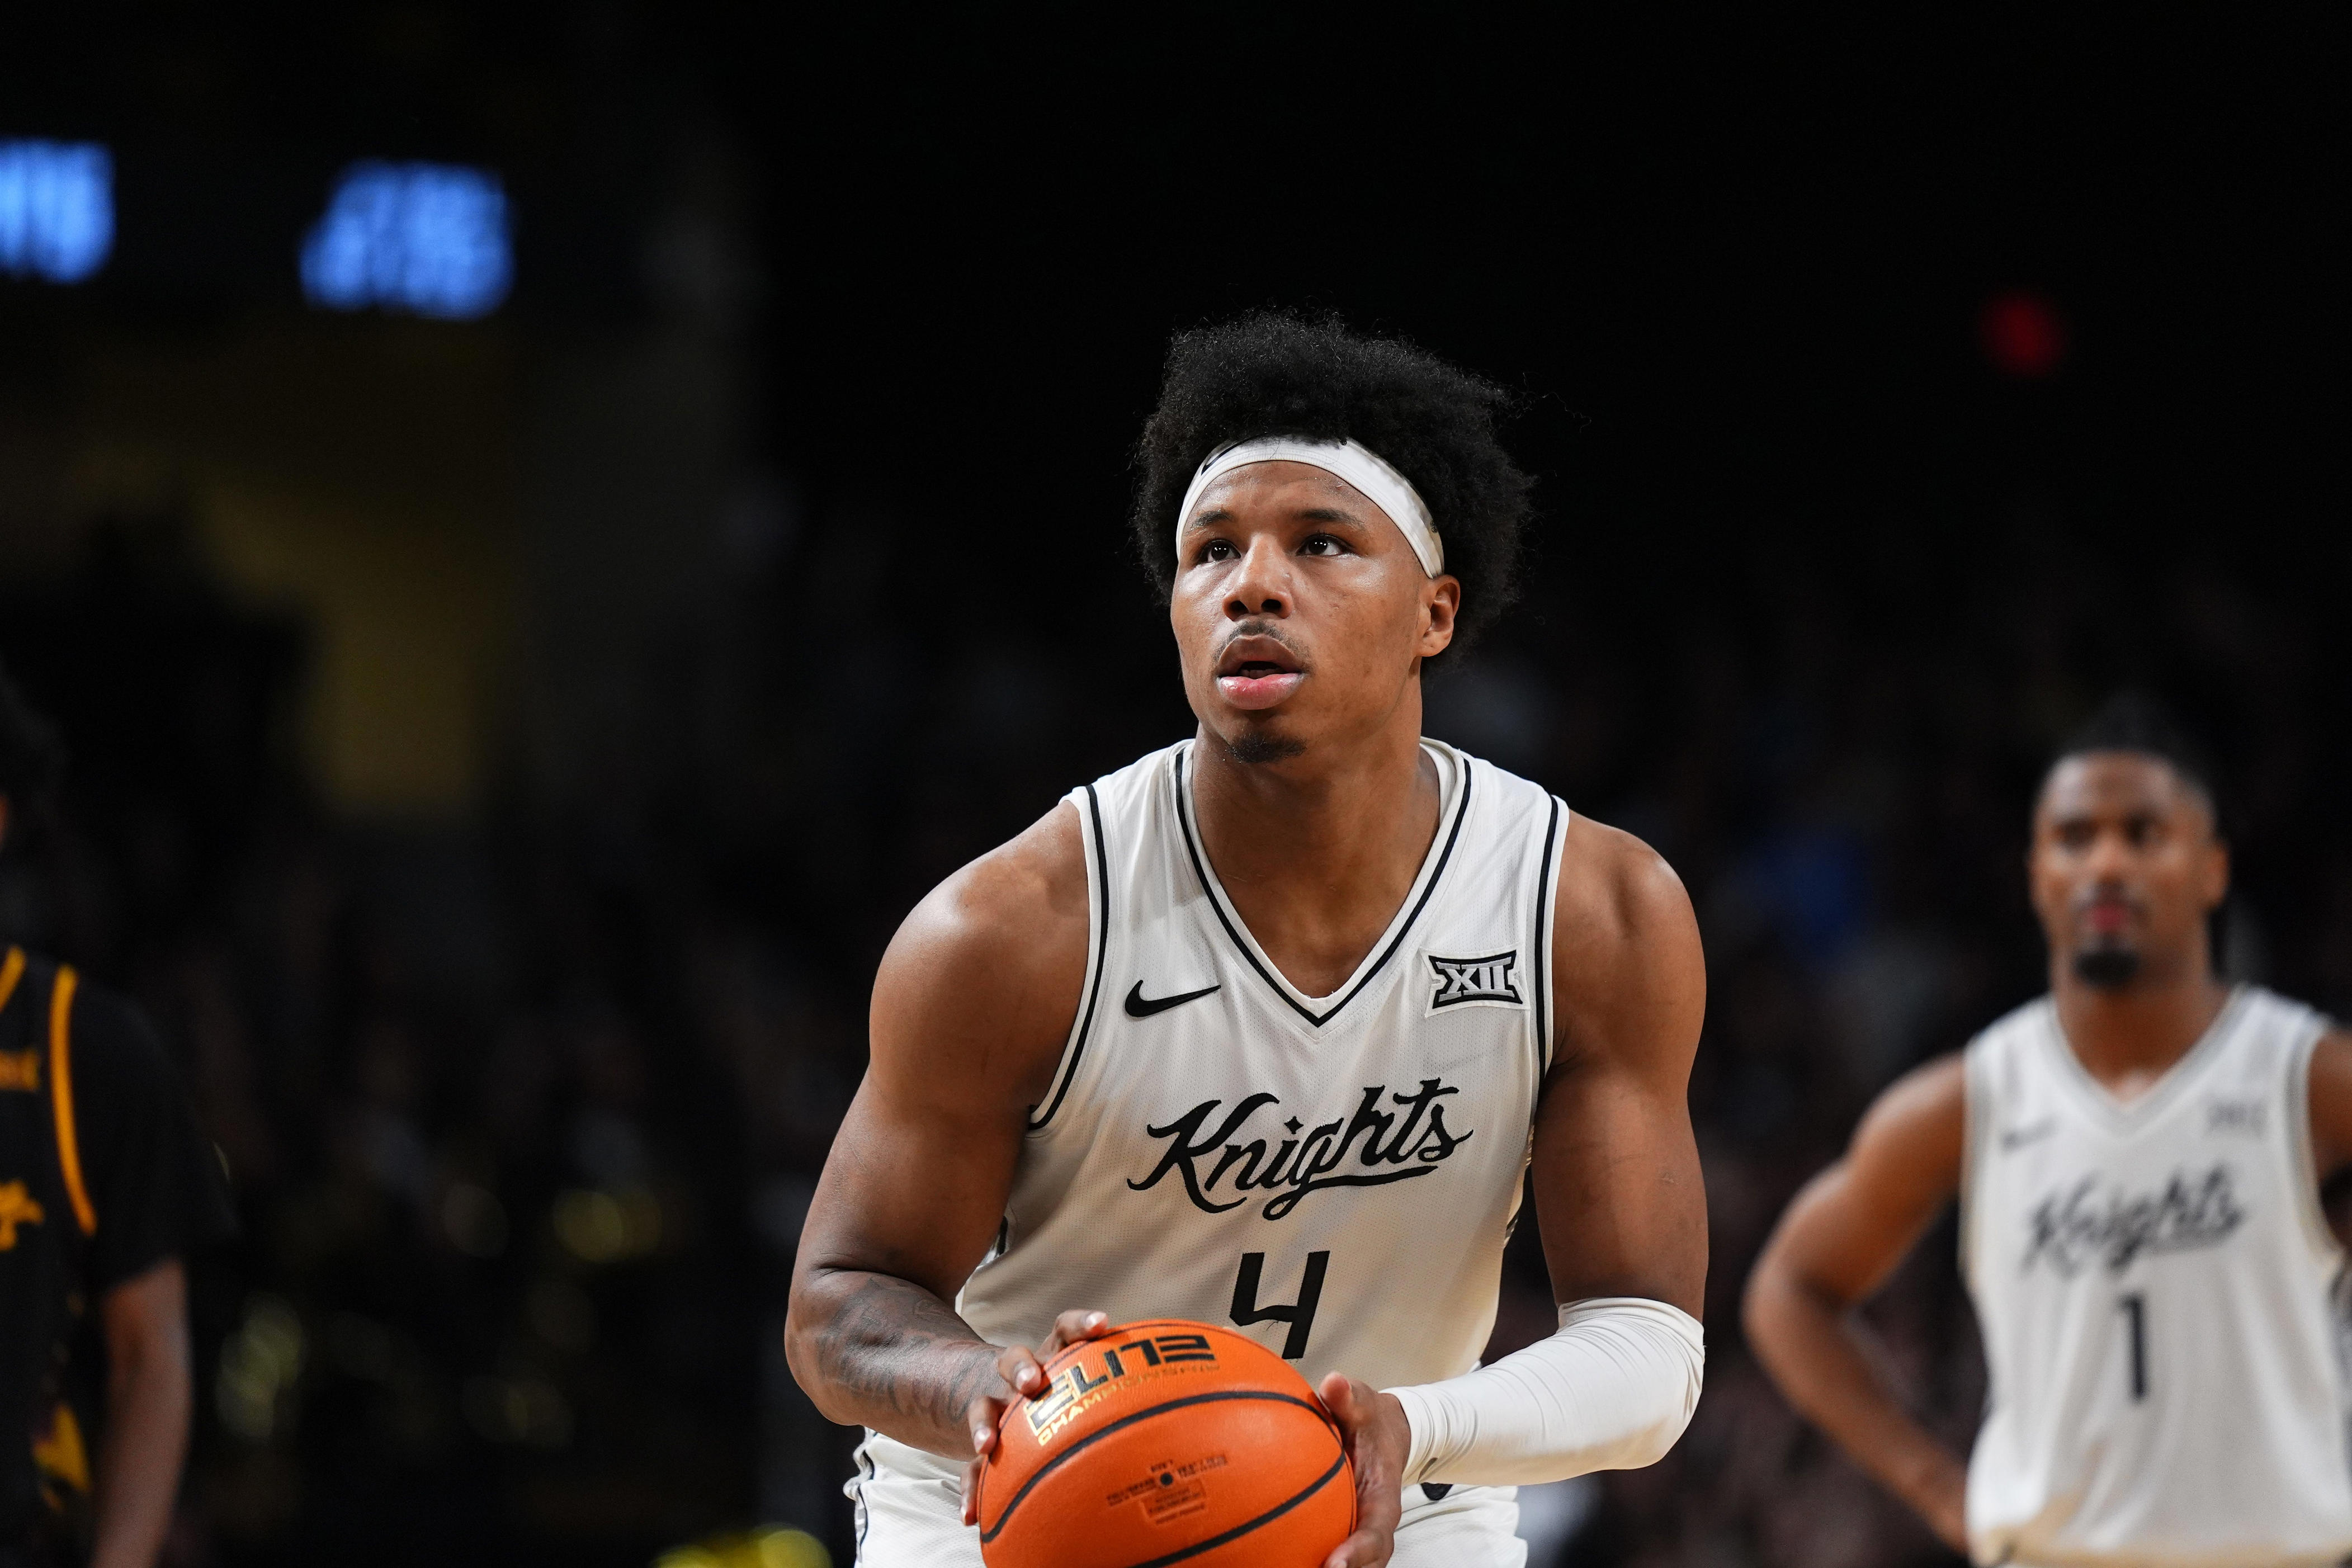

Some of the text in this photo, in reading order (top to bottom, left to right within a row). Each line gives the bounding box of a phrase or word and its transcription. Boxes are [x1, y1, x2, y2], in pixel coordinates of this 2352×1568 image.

[1435, 956, 1515, 1003] XII
[1127, 1077, 1473, 1221] Knights
[1229, 1250, 1330, 1359] 4
[2120, 1289, 2148, 1402] 1
[1023, 1334, 1216, 1436] ELITE
